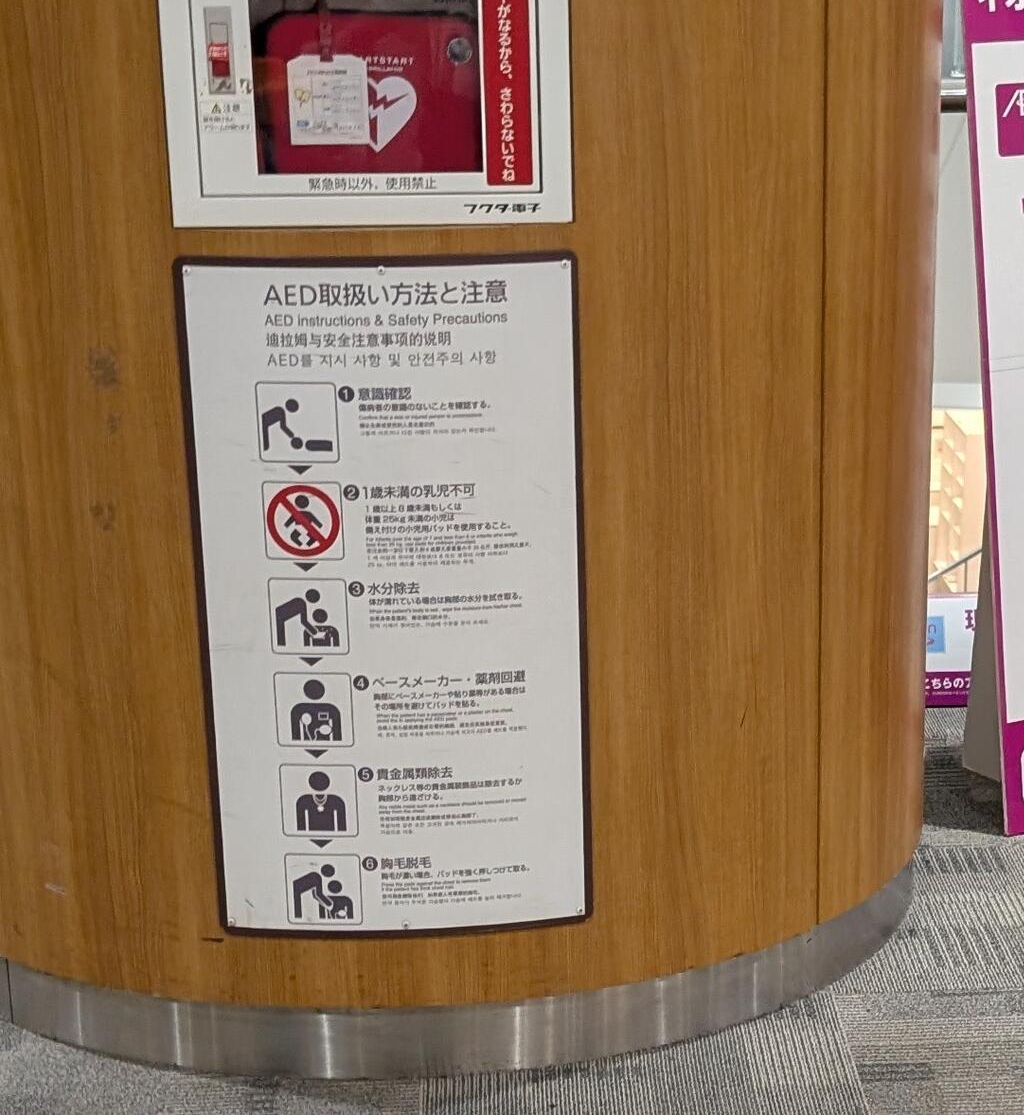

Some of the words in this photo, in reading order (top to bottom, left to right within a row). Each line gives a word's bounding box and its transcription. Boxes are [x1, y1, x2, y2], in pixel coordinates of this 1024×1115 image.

[308, 175, 437, 191] 緊急時以外、使用禁止
[263, 279, 508, 307] AED取扱い方法と注意
[264, 314, 294, 327] AED
[297, 313, 371, 327] Instructions
[374, 313, 384, 326] &
[388, 312, 429, 328] Safety
[433, 311, 508, 326] Precautions
[358, 386, 412, 401] 意識確認
[362, 483, 476, 500] 1歳未満の乳児不可
[368, 581, 421, 596] 水分除去
[372, 669, 526, 688] ペースメーカー・薬剤回避
[376, 766, 453, 781] 貴金属類除去
[380, 856, 432, 870] 胸毛脱毛
